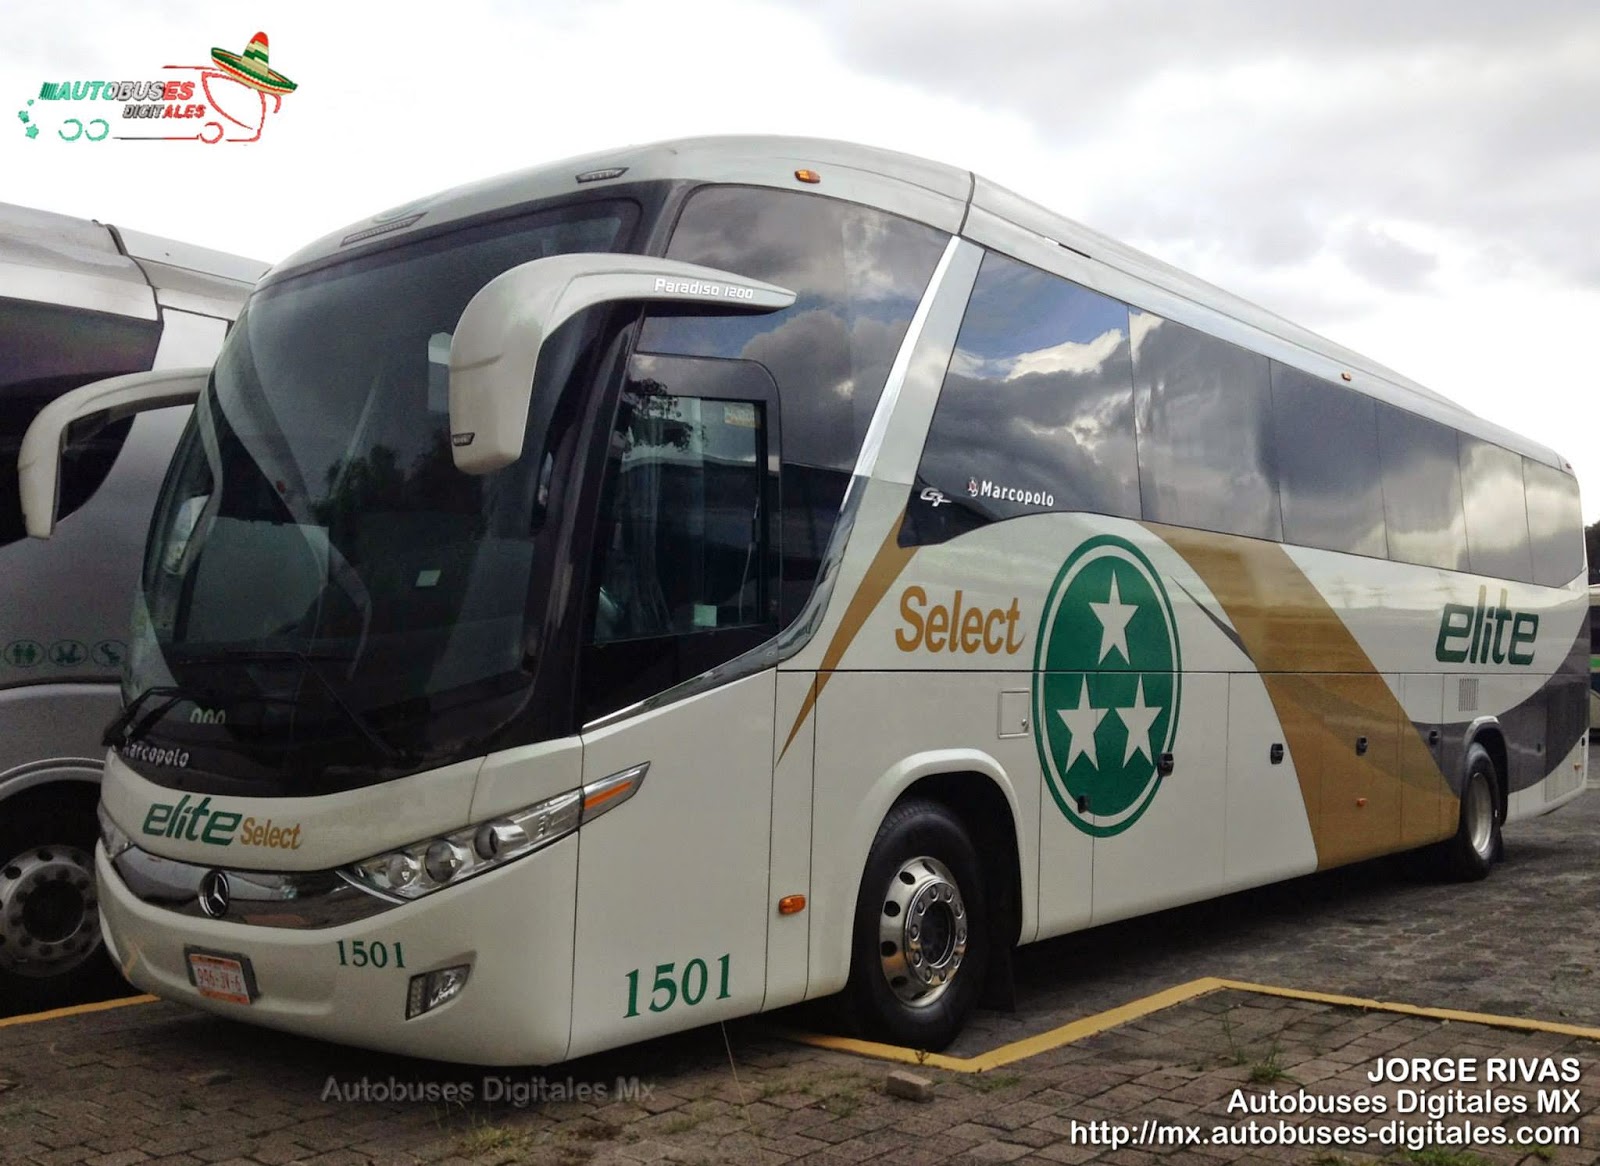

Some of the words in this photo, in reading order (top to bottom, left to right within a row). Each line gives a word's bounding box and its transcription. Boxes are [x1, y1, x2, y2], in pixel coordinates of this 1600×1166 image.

[654, 278, 720, 297] Paradiso
[724, 286, 754, 300] 1200
[981, 480, 1055, 507] Marcopolo
[895, 585, 1026, 655] Select
[1435, 584, 1539, 666] elite
[142, 794, 243, 846] elite
[240, 817, 301, 850] Select
[336, 940, 406, 968] 1501
[622, 953, 732, 1019] 1501
